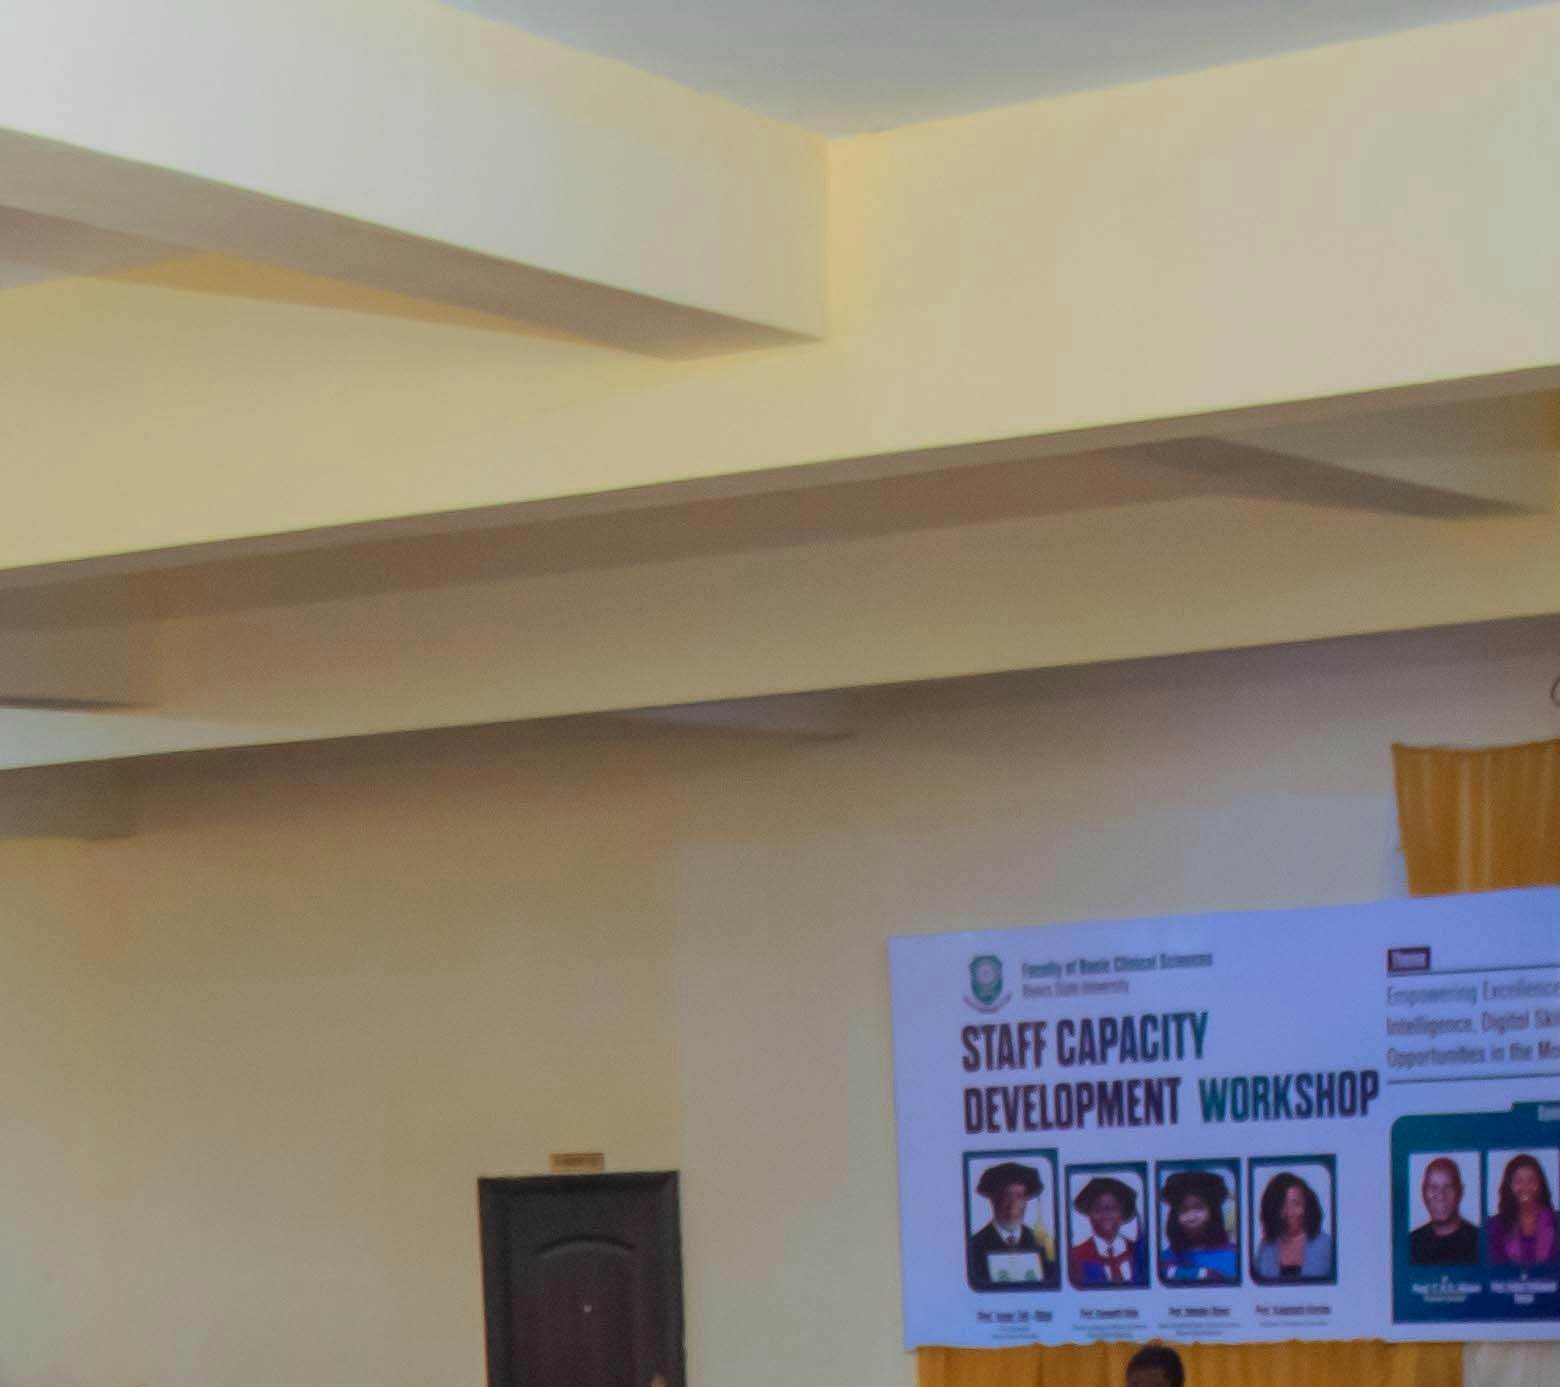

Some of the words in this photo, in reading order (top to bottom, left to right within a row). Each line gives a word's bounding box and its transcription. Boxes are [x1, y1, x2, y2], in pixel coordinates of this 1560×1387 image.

[961, 1021, 1047, 1072] STAFF
[1056, 1011, 1208, 1068] CAPACITY
[1482, 1009, 1529, 1034] Digital
[1387, 1047, 1485, 1069] Opportunities
[1490, 1045, 1505, 1062] in
[1509, 1042, 1533, 1061] the
[963, 1076, 1181, 1134] DEVELOPMENT
[1198, 1070, 1379, 1124] WORKSHOP
